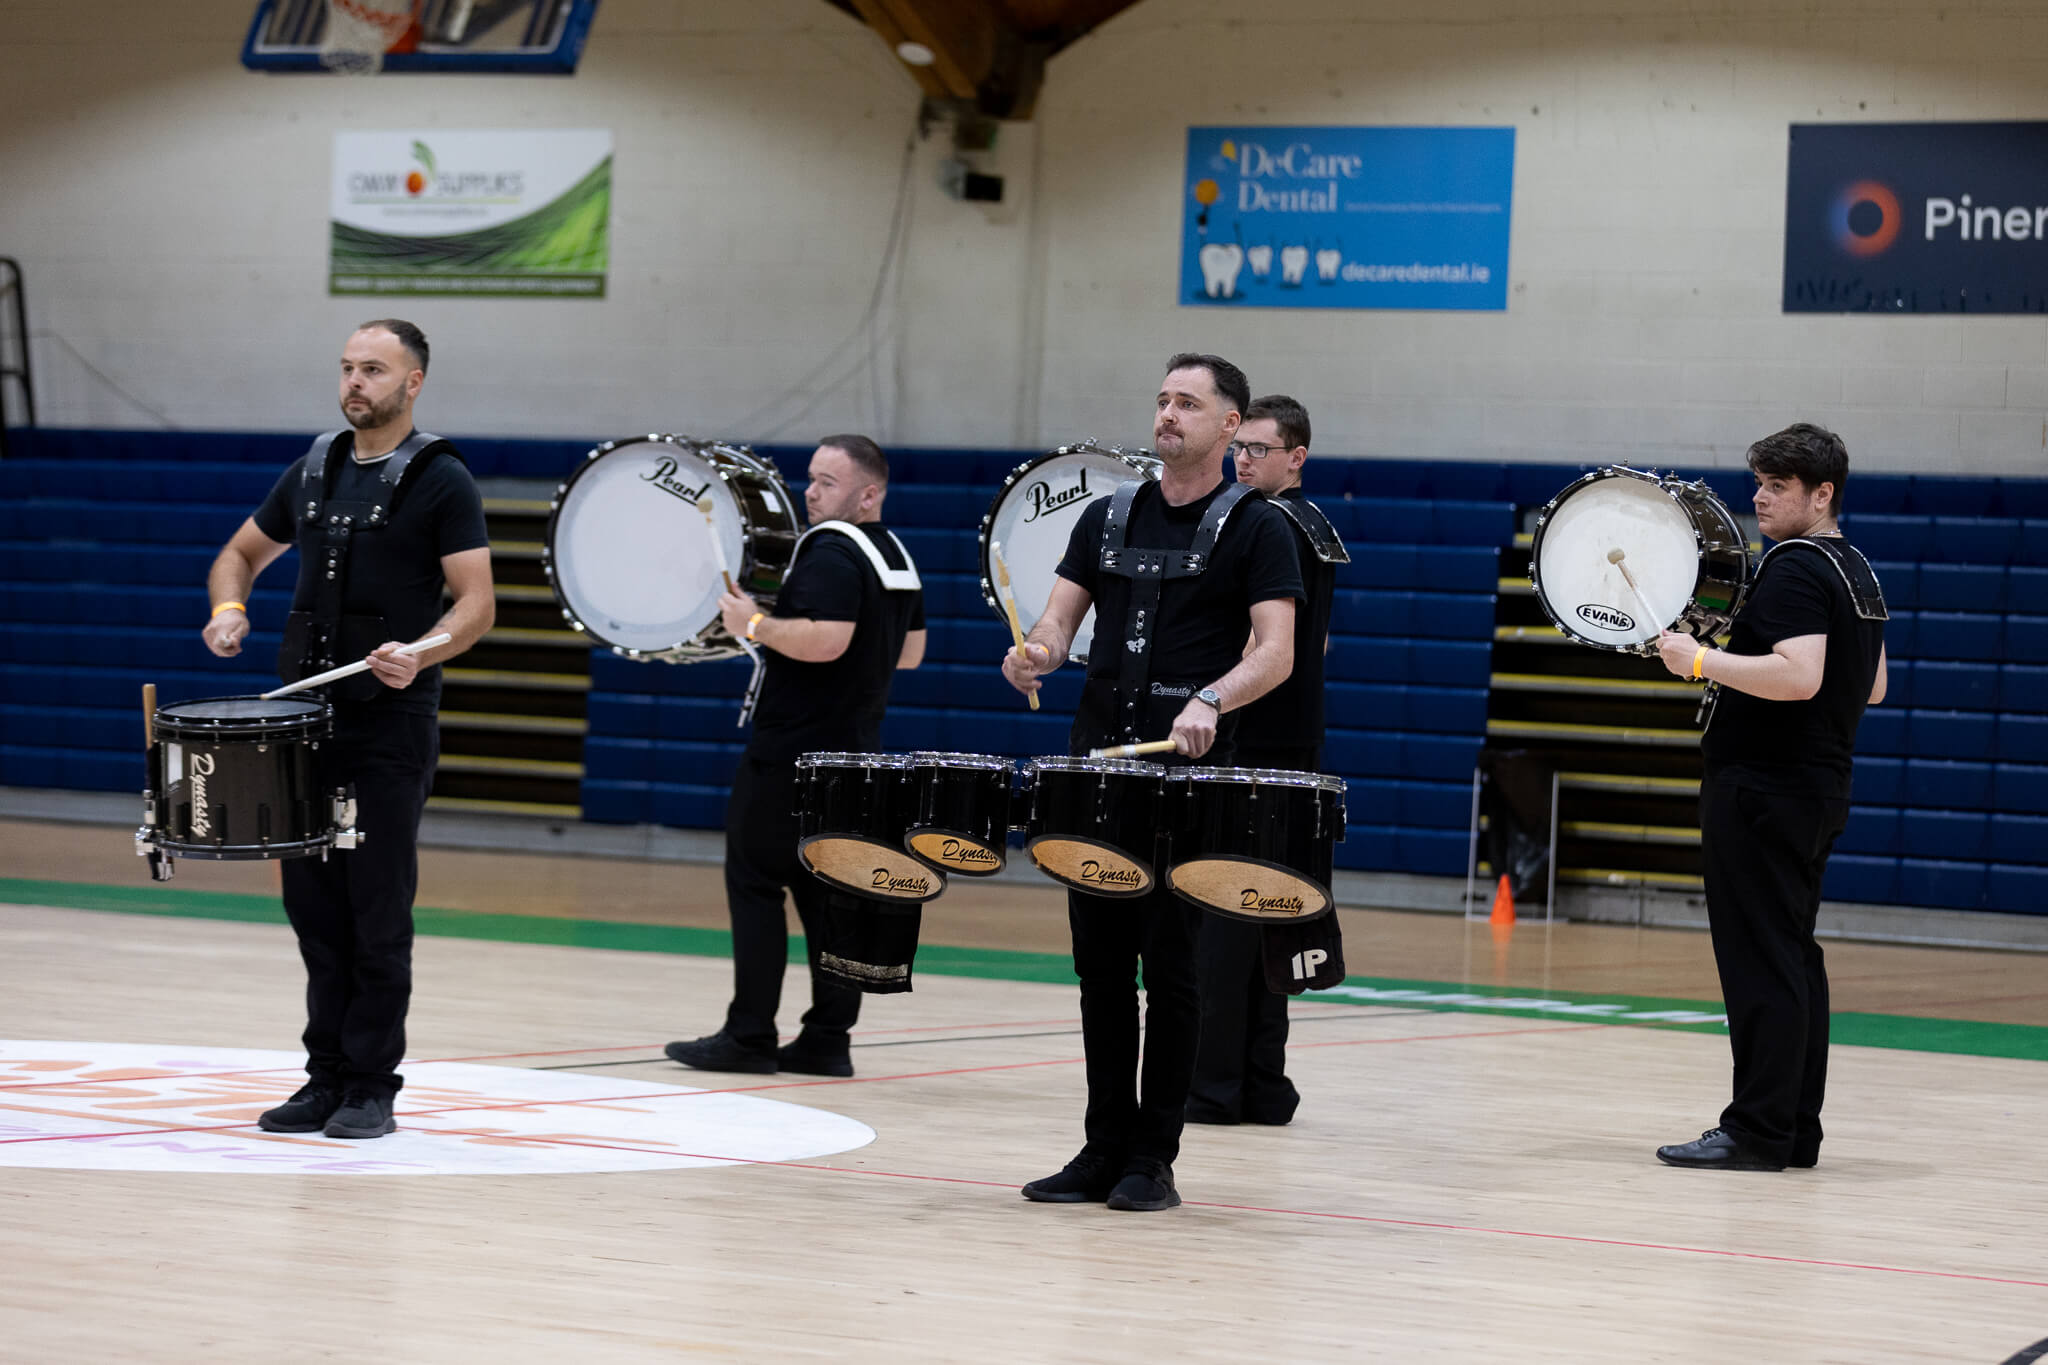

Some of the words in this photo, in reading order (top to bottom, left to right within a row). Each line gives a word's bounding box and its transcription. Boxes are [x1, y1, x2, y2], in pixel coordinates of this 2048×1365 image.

[1240, 142, 1363, 178] DeCare
[1238, 180, 1338, 213] Dental
[1341, 261, 1491, 284] decaredental.ie
[639, 455, 711, 501] Pearl
[1023, 467, 1088, 523] Pearl
[1582, 607, 1629, 628] EVANS
[1151, 682, 1192, 698] Dynasty
[189, 752, 216, 838] Dynasty
[871, 867, 930, 896] Dynasty
[1080, 860, 1141, 888] Dynasty
[1240, 888, 1304, 915] Dynasty
